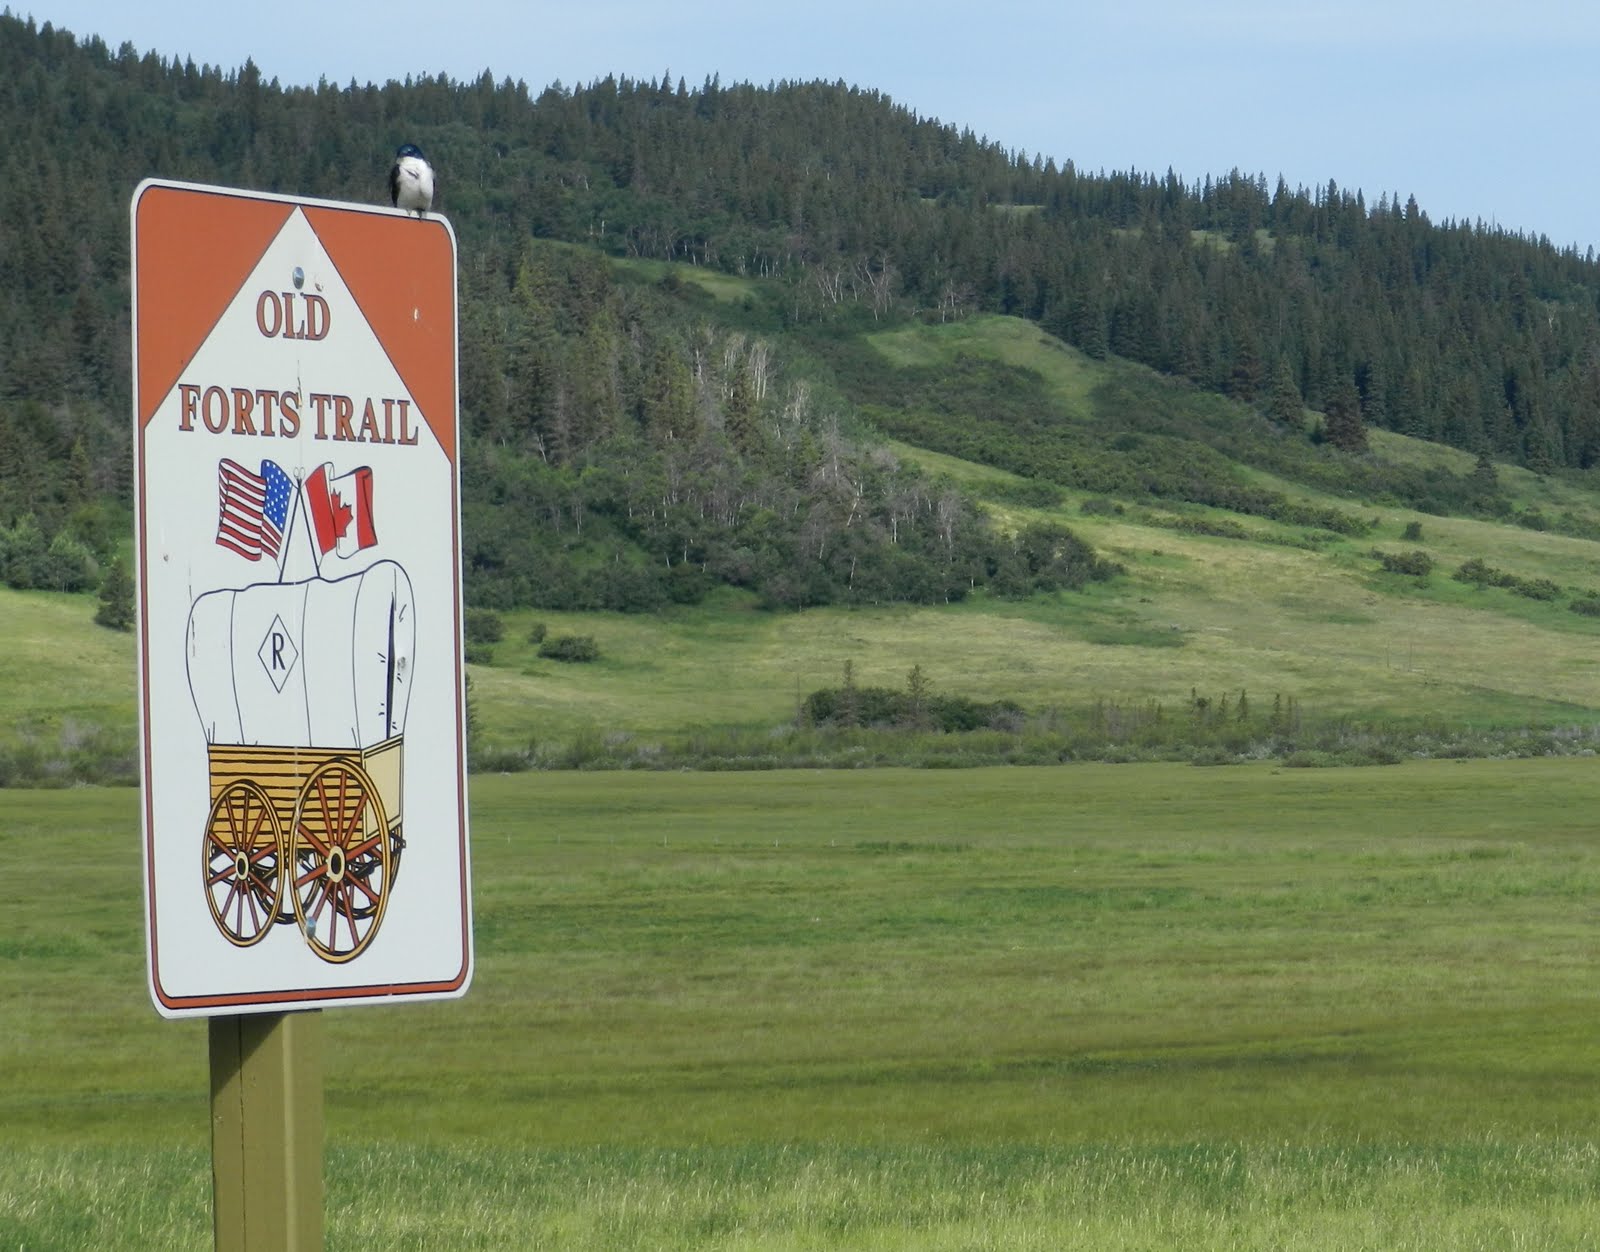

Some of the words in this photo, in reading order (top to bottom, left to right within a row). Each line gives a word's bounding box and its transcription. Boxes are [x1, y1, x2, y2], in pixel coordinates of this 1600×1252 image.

[256, 290, 331, 340] OLD
[178, 383, 301, 439] FORTS
[310, 393, 419, 446] TRAIL
[272, 632, 286, 670] R
